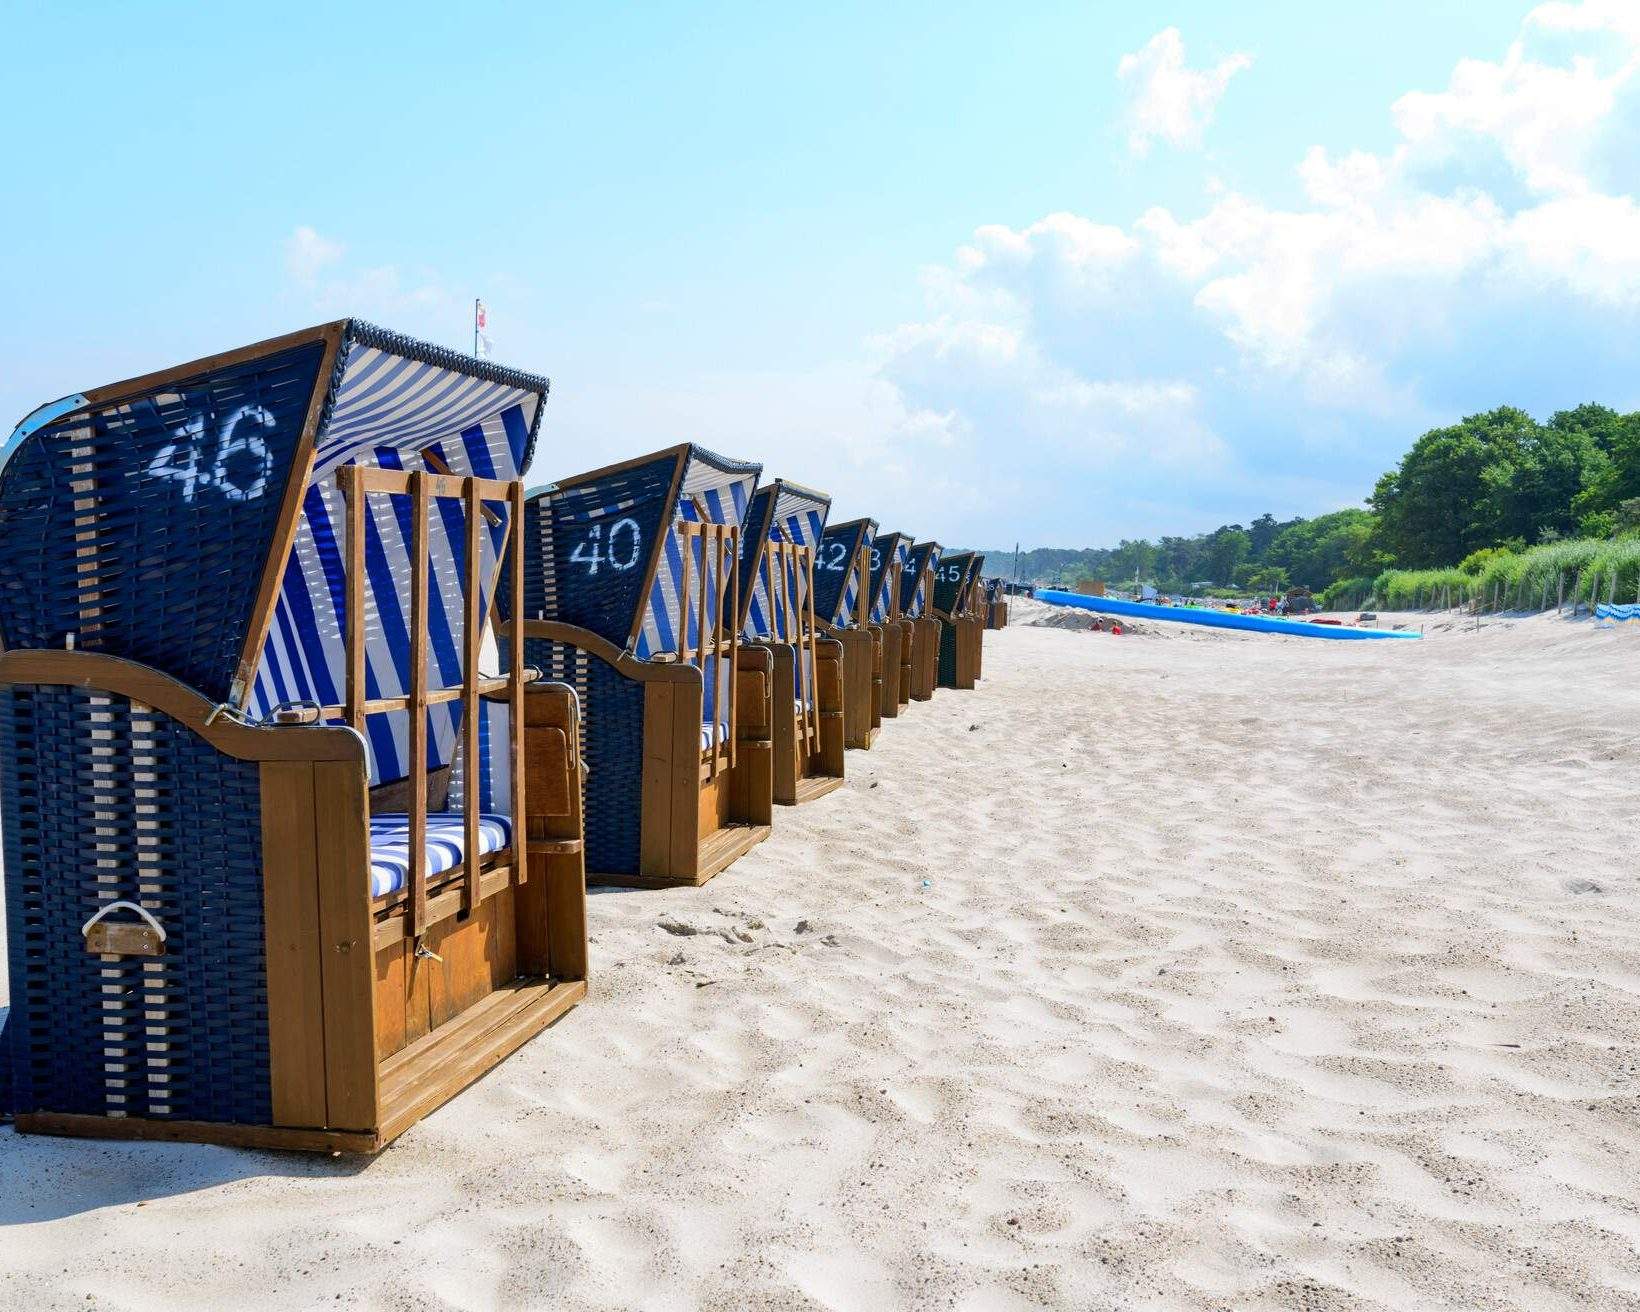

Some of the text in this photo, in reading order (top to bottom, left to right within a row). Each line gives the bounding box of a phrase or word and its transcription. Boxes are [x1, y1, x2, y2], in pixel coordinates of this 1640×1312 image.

[148, 404, 277, 503] 46
[569, 518, 641, 575] 40
[814, 543, 847, 571] 42
[868, 549, 881, 571] 3
[904, 558, 917, 575] 4
[935, 566, 960, 583] 45
